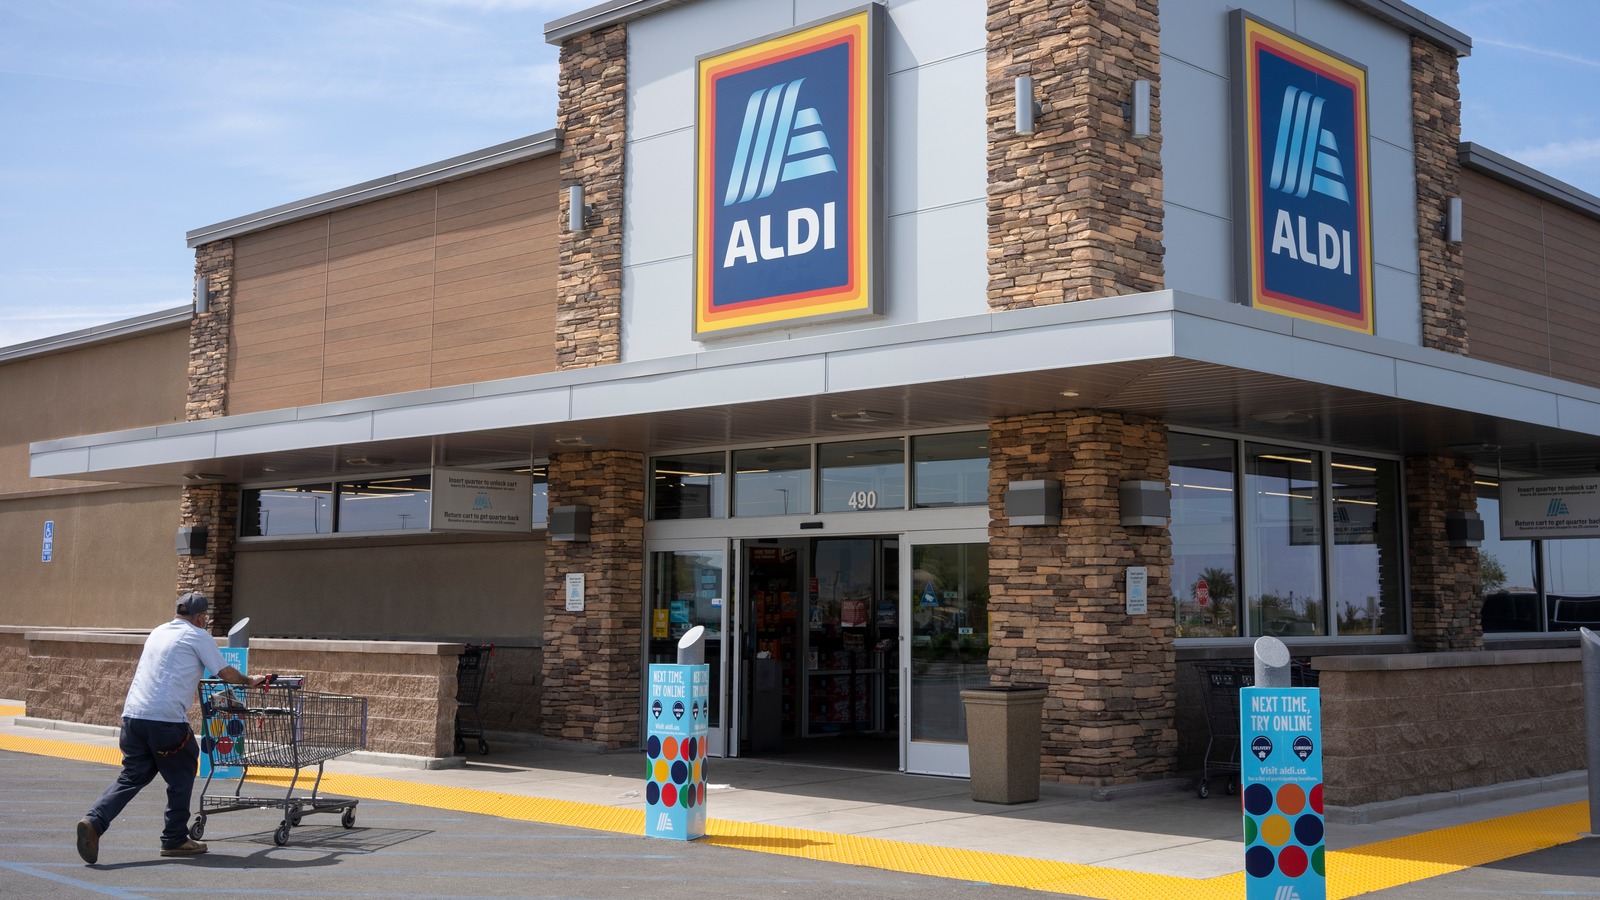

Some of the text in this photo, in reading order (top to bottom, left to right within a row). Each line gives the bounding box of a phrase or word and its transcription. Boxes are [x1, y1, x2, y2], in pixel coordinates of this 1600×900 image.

[723, 201, 836, 268] ALDI
[1271, 208, 1352, 276] ALDI
[848, 491, 876, 509] 490
[654, 671, 684, 685] NEXT TIME,
[653, 685, 685, 697] TRY ONLINE
[1251, 696, 1311, 715] NEXT TIME,
[1250, 715, 1313, 731] TRY ONLINE
[1260, 766, 1307, 775] Visit aldi.us
